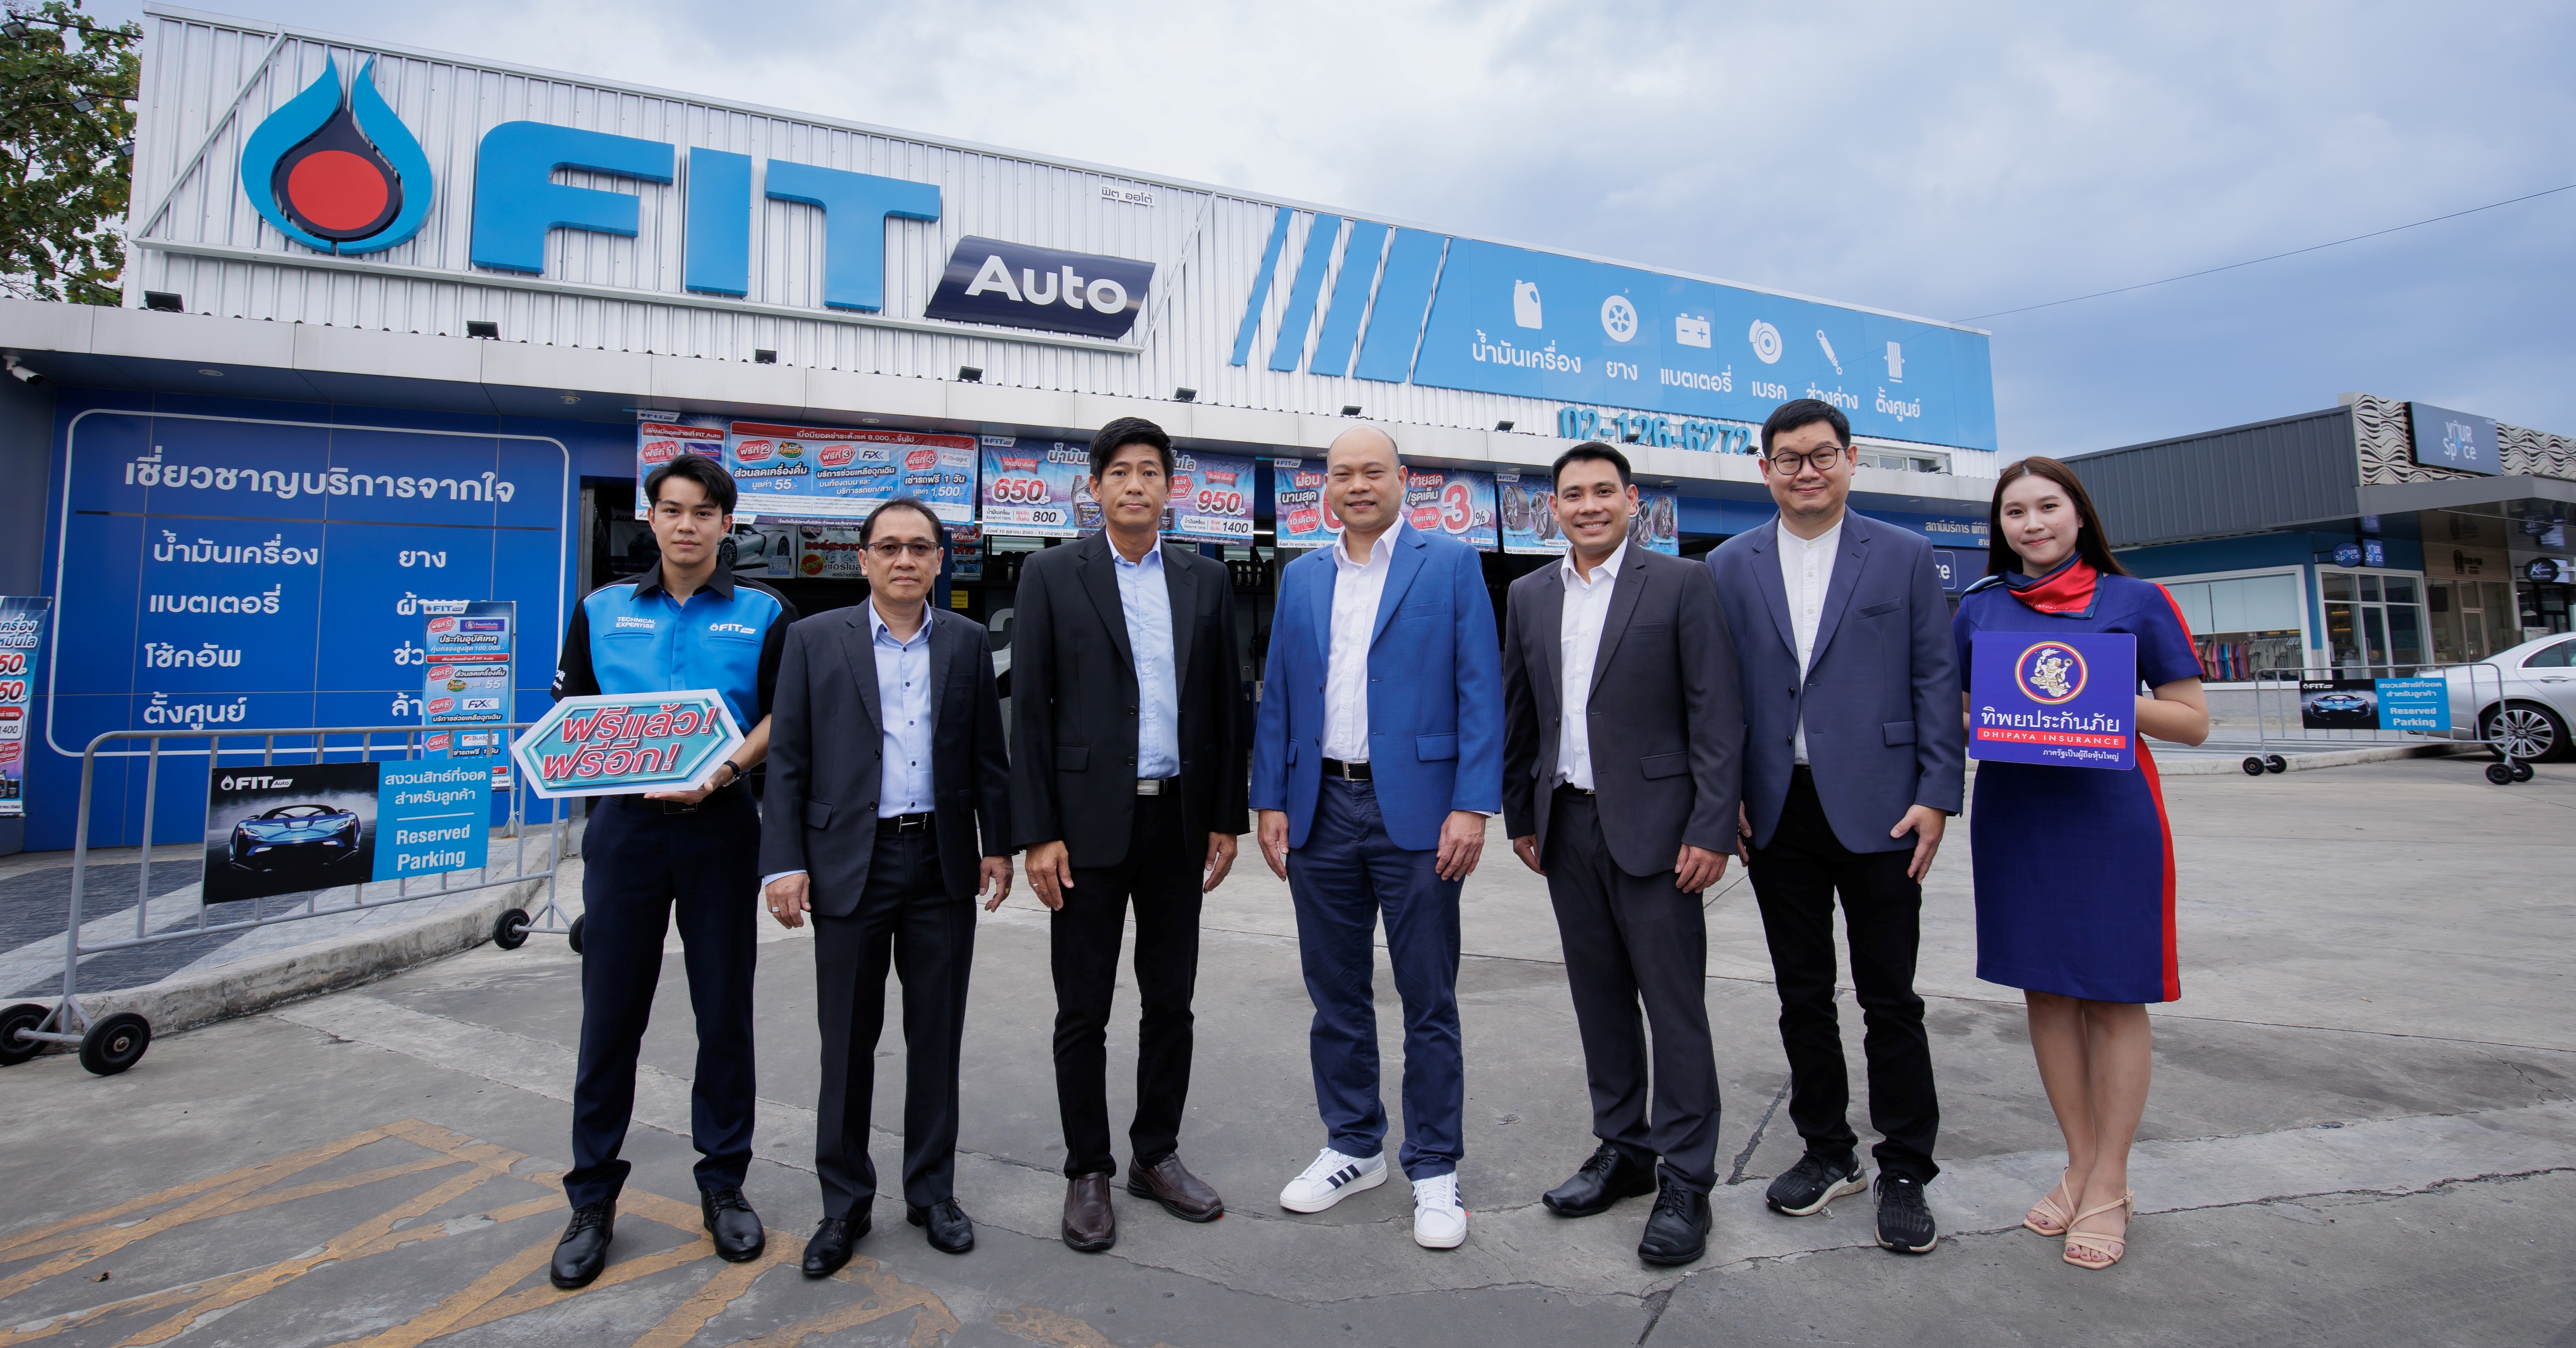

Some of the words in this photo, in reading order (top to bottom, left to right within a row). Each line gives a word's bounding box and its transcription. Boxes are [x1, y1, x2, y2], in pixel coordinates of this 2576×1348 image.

[1102, 187, 1119, 198] ฟิต
[1125, 192, 1153, 203] ออโต้
[472, 121, 941, 312] FIT
[965, 255, 1127, 314] Auto
[1472, 329, 1581, 374] น้ำมันเครื่อง
[1606, 360, 1638, 381] ยาง
[1660, 365, 1732, 393] แบตเตอรี่
[1752, 381, 1787, 400] เบรค
[1806, 382, 1858, 409] ช่วงล่าง
[1876, 387, 1921, 422] ตั้งศูนย์
[797, 429, 866, 440] เมื่อมียอดชำระตั้งแต่
[897, 434, 914, 442] ขึ้นไป
[1559, 406, 1752, 455] 02-126-6272
[645, 445, 666, 457] ฟรีที่
[740, 444, 759, 455] ฟรีที่
[761, 444, 770, 454] 2
[822, 449, 842, 460] ฟรีที่
[842, 449, 851, 459] 3
[908, 454, 926, 464] ฟรีที่
[927, 454, 934, 464] 4
[125, 445, 515, 503] เชี่ยวชาญบริการจากใจ
[734, 462, 808, 477] ส่วนลดเครื่องดื่ม
[817, 467, 895, 477] บริการช่วยเหลือฉุกเฉิน
[752, 480, 772, 490] มูลค่า
[775, 479, 798, 490] 55.-
[820, 479, 857, 487] บนท้องถนน
[905, 473, 940, 484] เช่ารถฟรี
[953, 474, 965, 483] วัน
[1296, 472, 1321, 487] ผ่อน
[1410, 473, 1443, 486] จ่ายสด
[837, 485, 893, 495] บริการรถยก/ลาก
[913, 487, 928, 496] มูลค่า
[931, 486, 965, 498] 1,500.-
[993, 477, 1050, 503] 650.-
[1197, 489, 1244, 514] 950.-
[1282, 491, 1317, 505] นานสุด
[1442, 482, 1472, 532] 3
[1033, 511, 1059, 523] 800.-
[1298, 515, 1316, 524] เดือน
[1413, 511, 1436, 523] ลดเพิ่ม
[1476, 510, 1485, 524] %
[1925, 519, 1969, 534] สถานีบริการ
[1972, 521, 1988, 534] พีทีที
[154, 530, 319, 565] น้ำมันเครื่อง
[399, 550, 446, 568] ยาง
[149, 583, 281, 614] แบตเตอรี่
[432, 620, 445, 629] ฟรีที่
[719, 623, 743, 632] FIT
[439, 635, 497, 644] ประกันอุบัติเหตุ
[144, 641, 241, 668] โช้คอัพ
[431, 669, 444, 677] ฟรีที่
[445, 667, 452, 675] 2
[455, 667, 506, 677] ส่วนลดเครื่องดื่ม
[2386, 690, 2437, 698] สำหรับลูกค้า
[143, 692, 247, 730] ตั้งศูนย์
[430, 701, 444, 710] ฟรีที่
[433, 714, 501, 723] บริการช่วยเหลือฉุกเฉิน
[562, 703, 717, 743] ฟรีแล้ว!
[1981, 706, 2120, 732] ทิพยประกันภัย
[2393, 718, 2436, 728] Parking
[430, 738, 443, 746] ฟรีที่
[1983, 731, 2036, 740] DHIPAYA
[2043, 734, 2120, 745] INSURANCE
[454, 748, 479, 756] ช่ารถฟรี
[2043, 749, 2119, 762] ภาครัฐเป็นผู้ถือหุ้นใหญ่
[542, 739, 682, 780] ฟรีอีก!
[236, 776, 274, 790] FIT
[395, 788, 476, 806] สำหรับลูกค้า
[396, 824, 470, 845] Reserved
[397, 850, 466, 872] Parking
